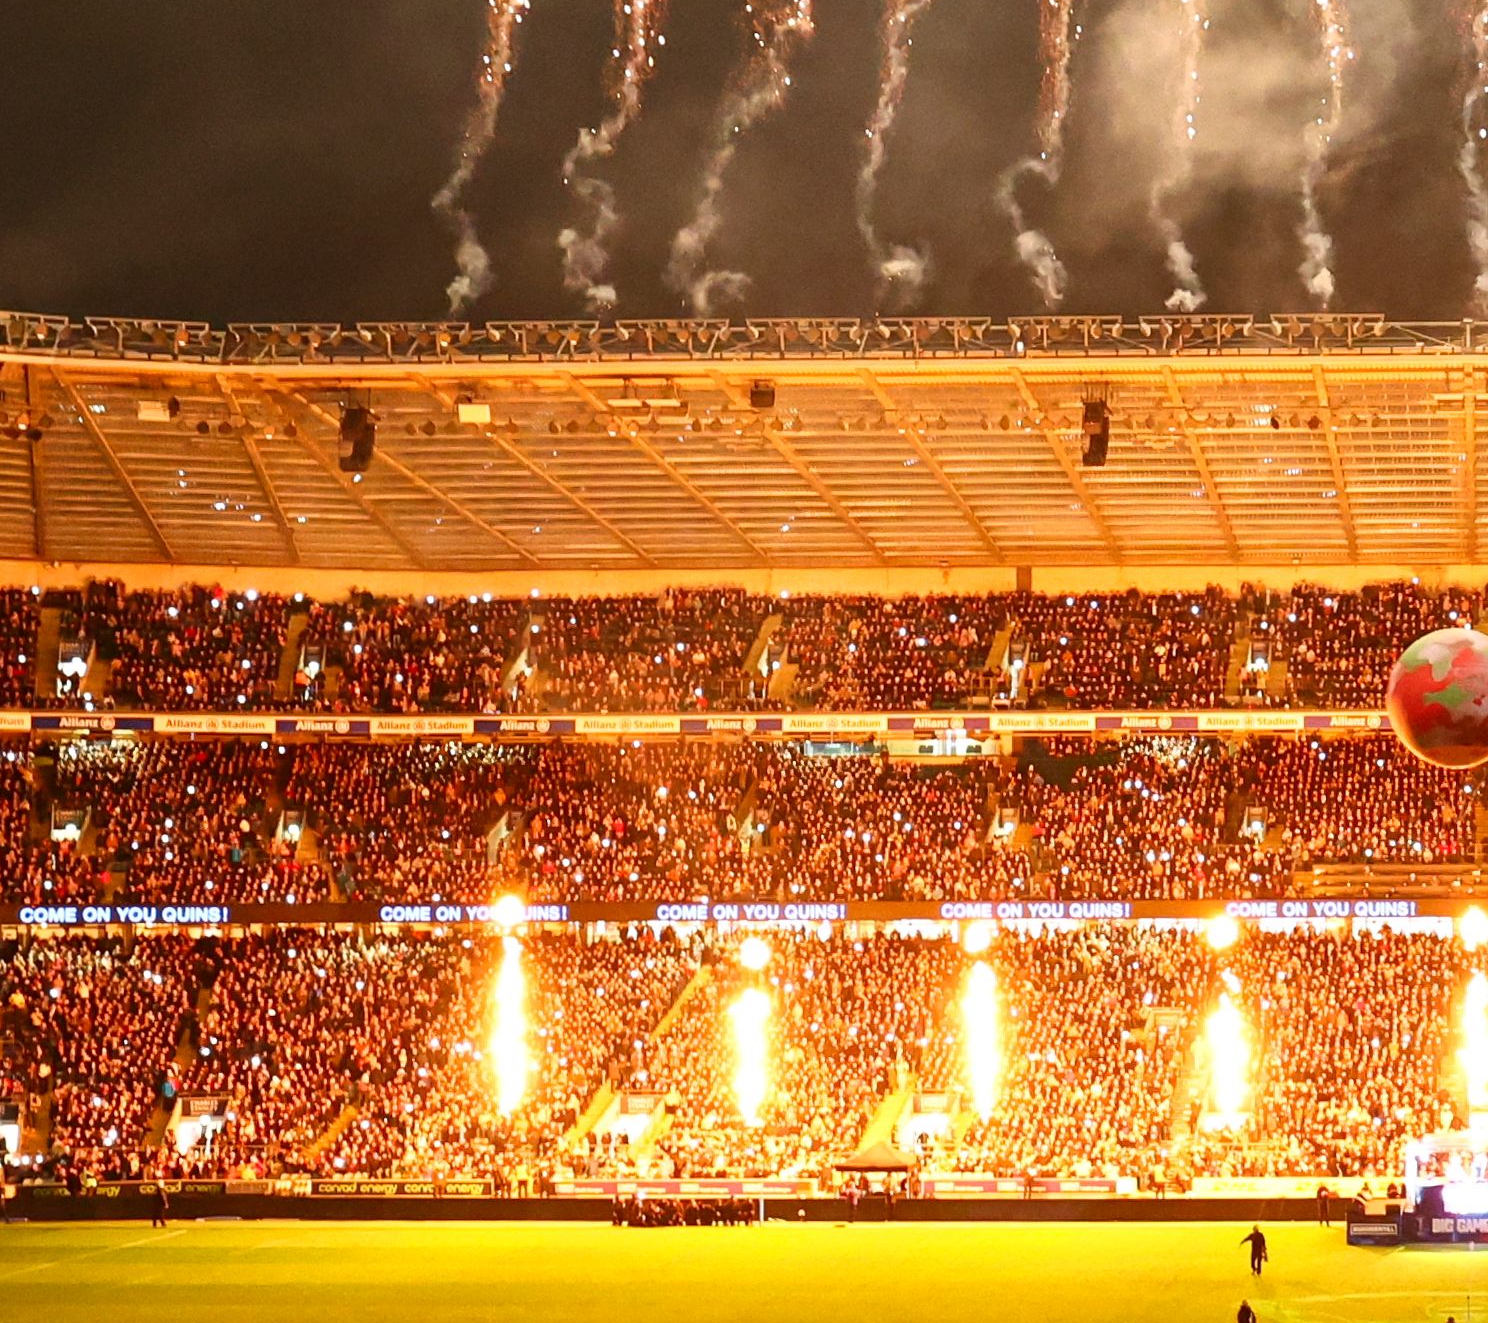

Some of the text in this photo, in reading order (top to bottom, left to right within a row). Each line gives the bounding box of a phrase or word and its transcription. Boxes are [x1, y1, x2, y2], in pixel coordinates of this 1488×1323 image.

[60, 716, 99, 728] Allianz
[501, 721, 536, 731] Allianz
[20, 906, 228, 923] COME ON YOU QUINS!
[381, 906, 431, 921] COME
[437, 906, 461, 921] ON
[657, 905, 845, 920] COME ON YOU QUINS!
[941, 903, 1130, 919] COME ON YOU QUINS!
[1226, 901, 1415, 917] COME ON YOU QUINS!
